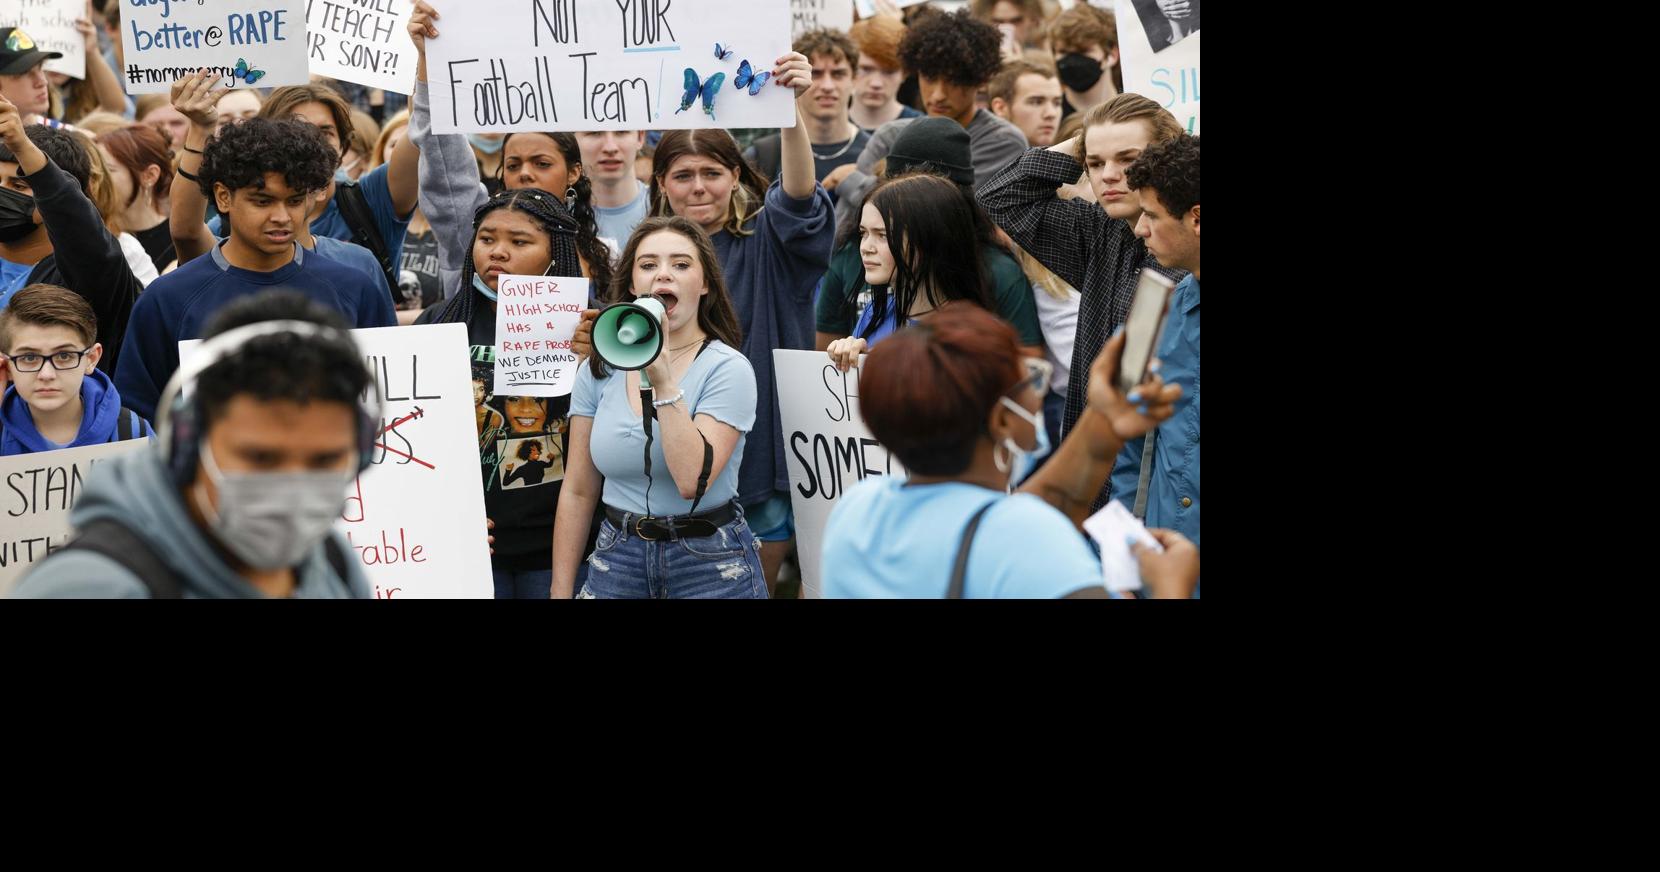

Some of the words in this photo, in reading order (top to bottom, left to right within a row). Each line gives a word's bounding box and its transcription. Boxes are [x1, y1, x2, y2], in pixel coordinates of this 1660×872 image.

[228, 10, 288, 46] RAPE
[322, 1, 395, 43] TEACH
[616, 0, 676, 48] YOUR
[448, 56, 558, 127] Football
[501, 279, 561, 299] GUYER
[505, 303, 541, 317] HIGH
[544, 303, 584, 314] SCHOOL
[506, 322, 532, 334] HAS
[503, 341, 541, 353] RAPE
[498, 355, 521, 369] WE
[525, 353, 576, 367] DEMAND
[505, 368, 561, 383] JUSTICE
